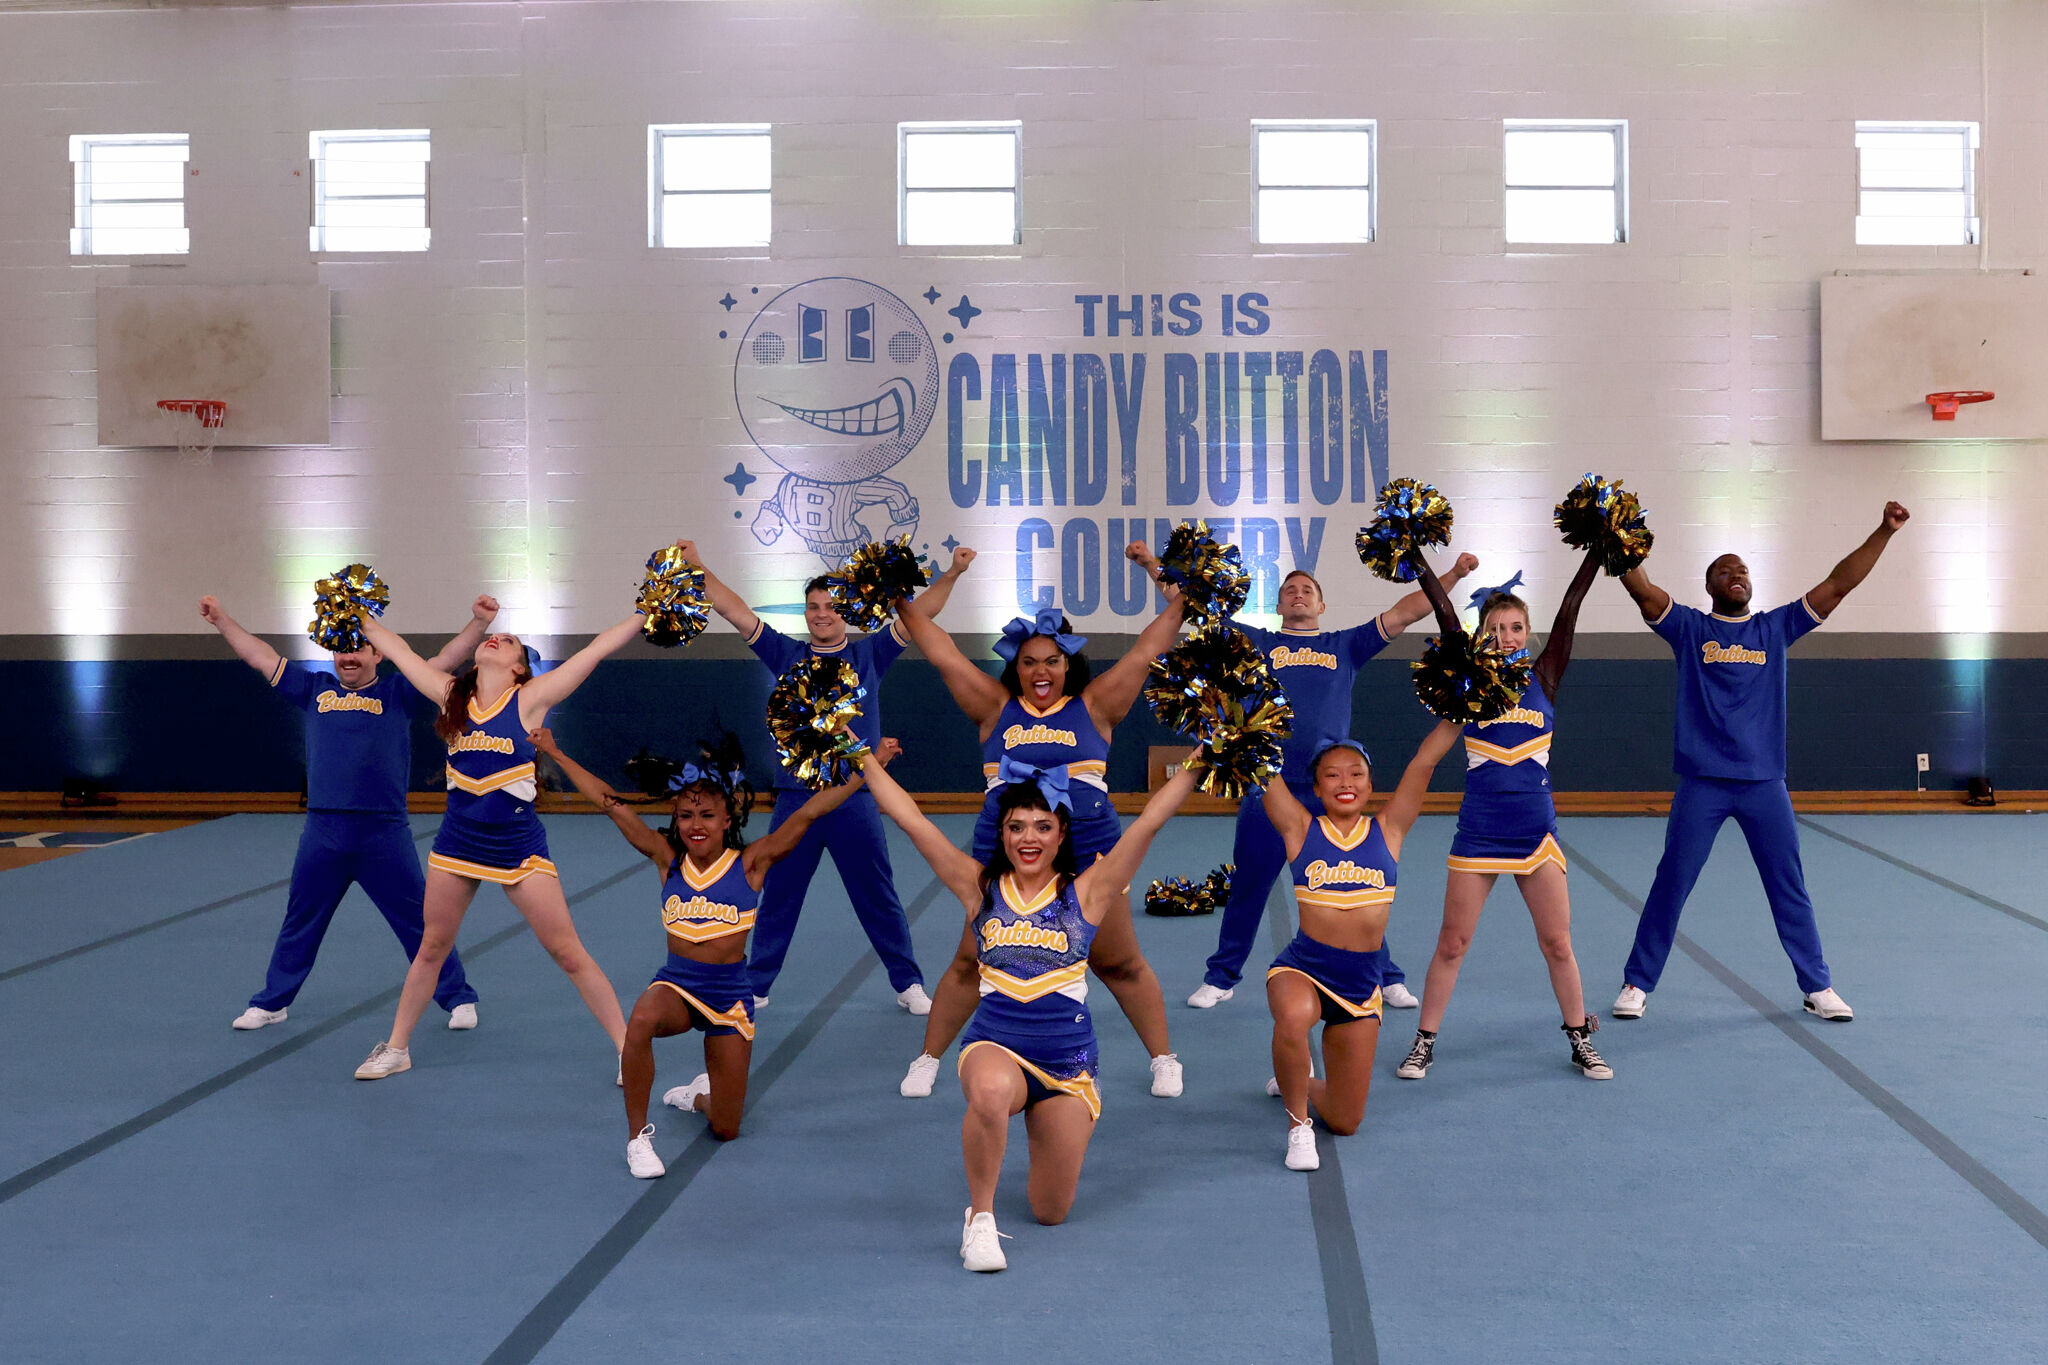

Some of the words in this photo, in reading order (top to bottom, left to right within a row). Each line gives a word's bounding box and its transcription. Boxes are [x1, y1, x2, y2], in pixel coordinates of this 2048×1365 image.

[1074, 292, 1203, 337] THIS
[1221, 292, 1270, 337] IS
[947, 352, 1147, 508] CANDY
[1164, 348, 1390, 507] BUTTON
[1016, 516, 1327, 617] COURY
[1269, 645, 1338, 670] Buttons
[1701, 640, 1767, 665] Buttons
[316, 690, 383, 715] Buttons
[1002, 724, 1078, 750] Buttons
[1304, 859, 1386, 891] Buttons
[664, 894, 740, 925] Buttons
[980, 917, 1069, 954] Buttons
